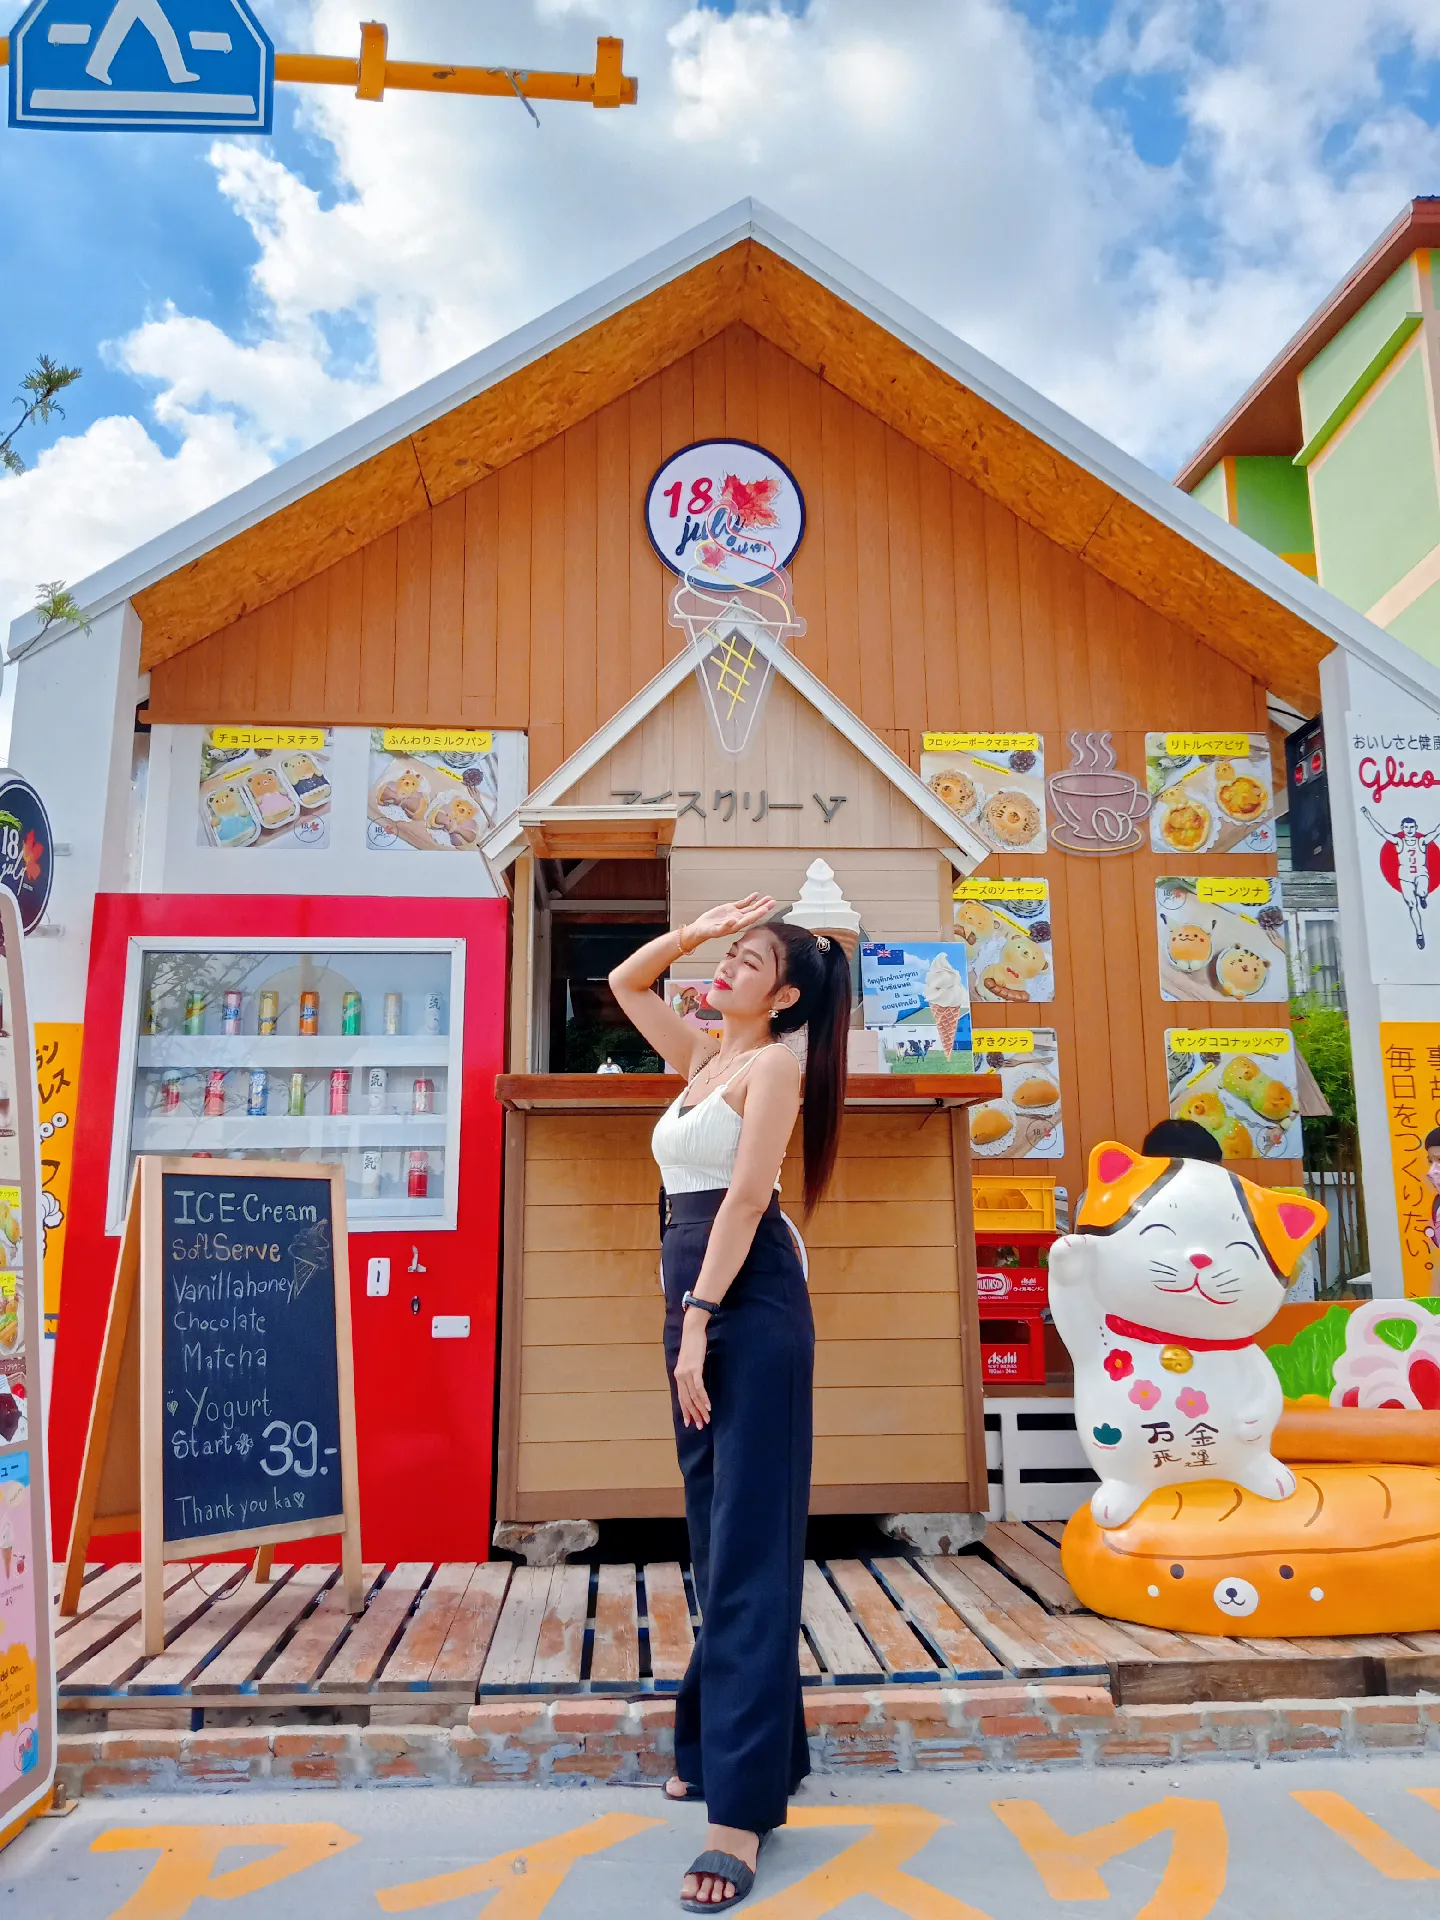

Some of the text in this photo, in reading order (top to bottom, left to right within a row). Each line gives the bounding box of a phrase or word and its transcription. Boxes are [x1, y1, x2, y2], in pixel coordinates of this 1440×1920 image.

[663, 477, 713, 518] 18
[218, 733, 319, 744] チョコレートヌテラ
[388, 735, 487, 747] ふんわりミルクパン
[1358, 755, 1440, 804] Glico
[2, 825, 20, 860] 18
[1203, 886, 1263, 897] コーンツナ
[173, 1306, 266, 1333] Chocolate
[183, 1341, 268, 1373] Matcha
[987, 1351, 1017, 1365] Asahi
[185, 1386, 273, 1429] Yogurt
[171, 1425, 233, 1459] Start
[174, 1486, 292, 1526] Thank you ka
